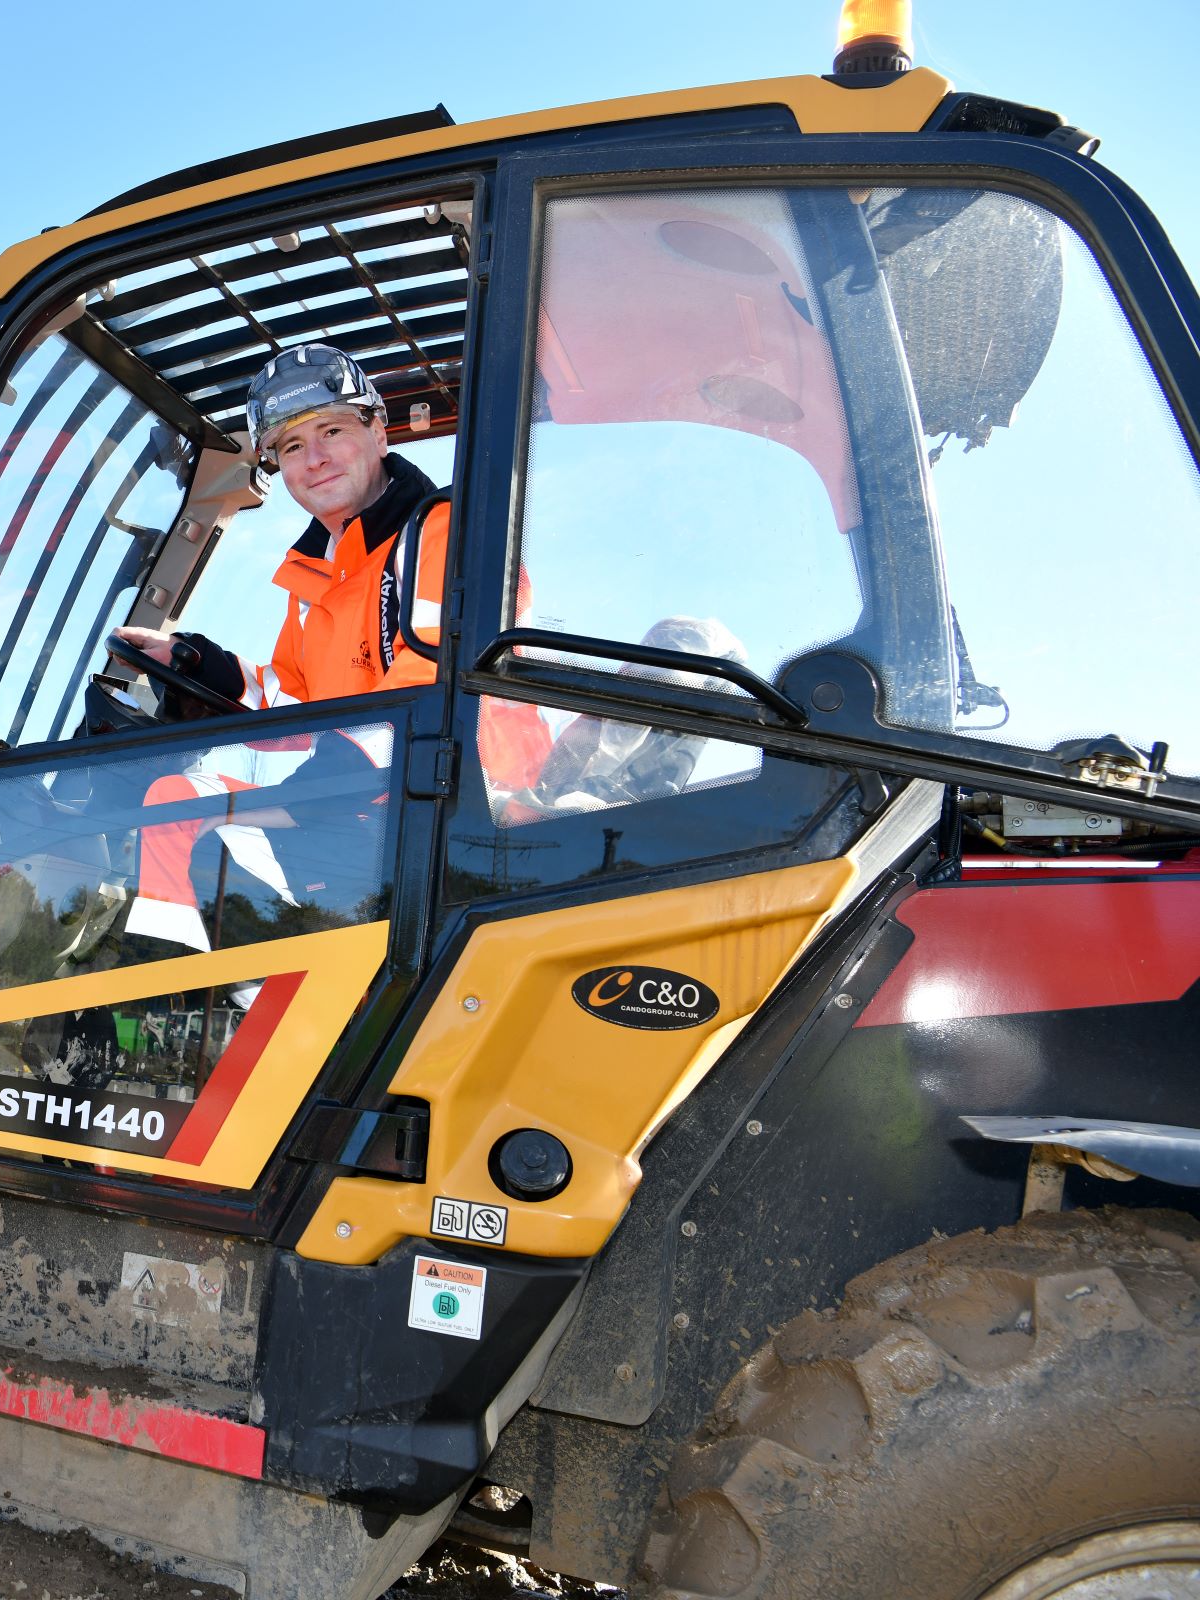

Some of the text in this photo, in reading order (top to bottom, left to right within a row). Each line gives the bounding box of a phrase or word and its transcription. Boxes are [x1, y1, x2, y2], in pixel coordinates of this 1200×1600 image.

[279, 381, 321, 402] RINGWAY
[381, 570, 394, 667] RINGWAY
[638, 979, 700, 1008] C&O
[620, 1004, 699, 1019] CANDOGROUP.CO.UK
[443, 1268, 474, 1281] CAUTION
[424, 1280, 472, 1296] Diesel Fuel Only
